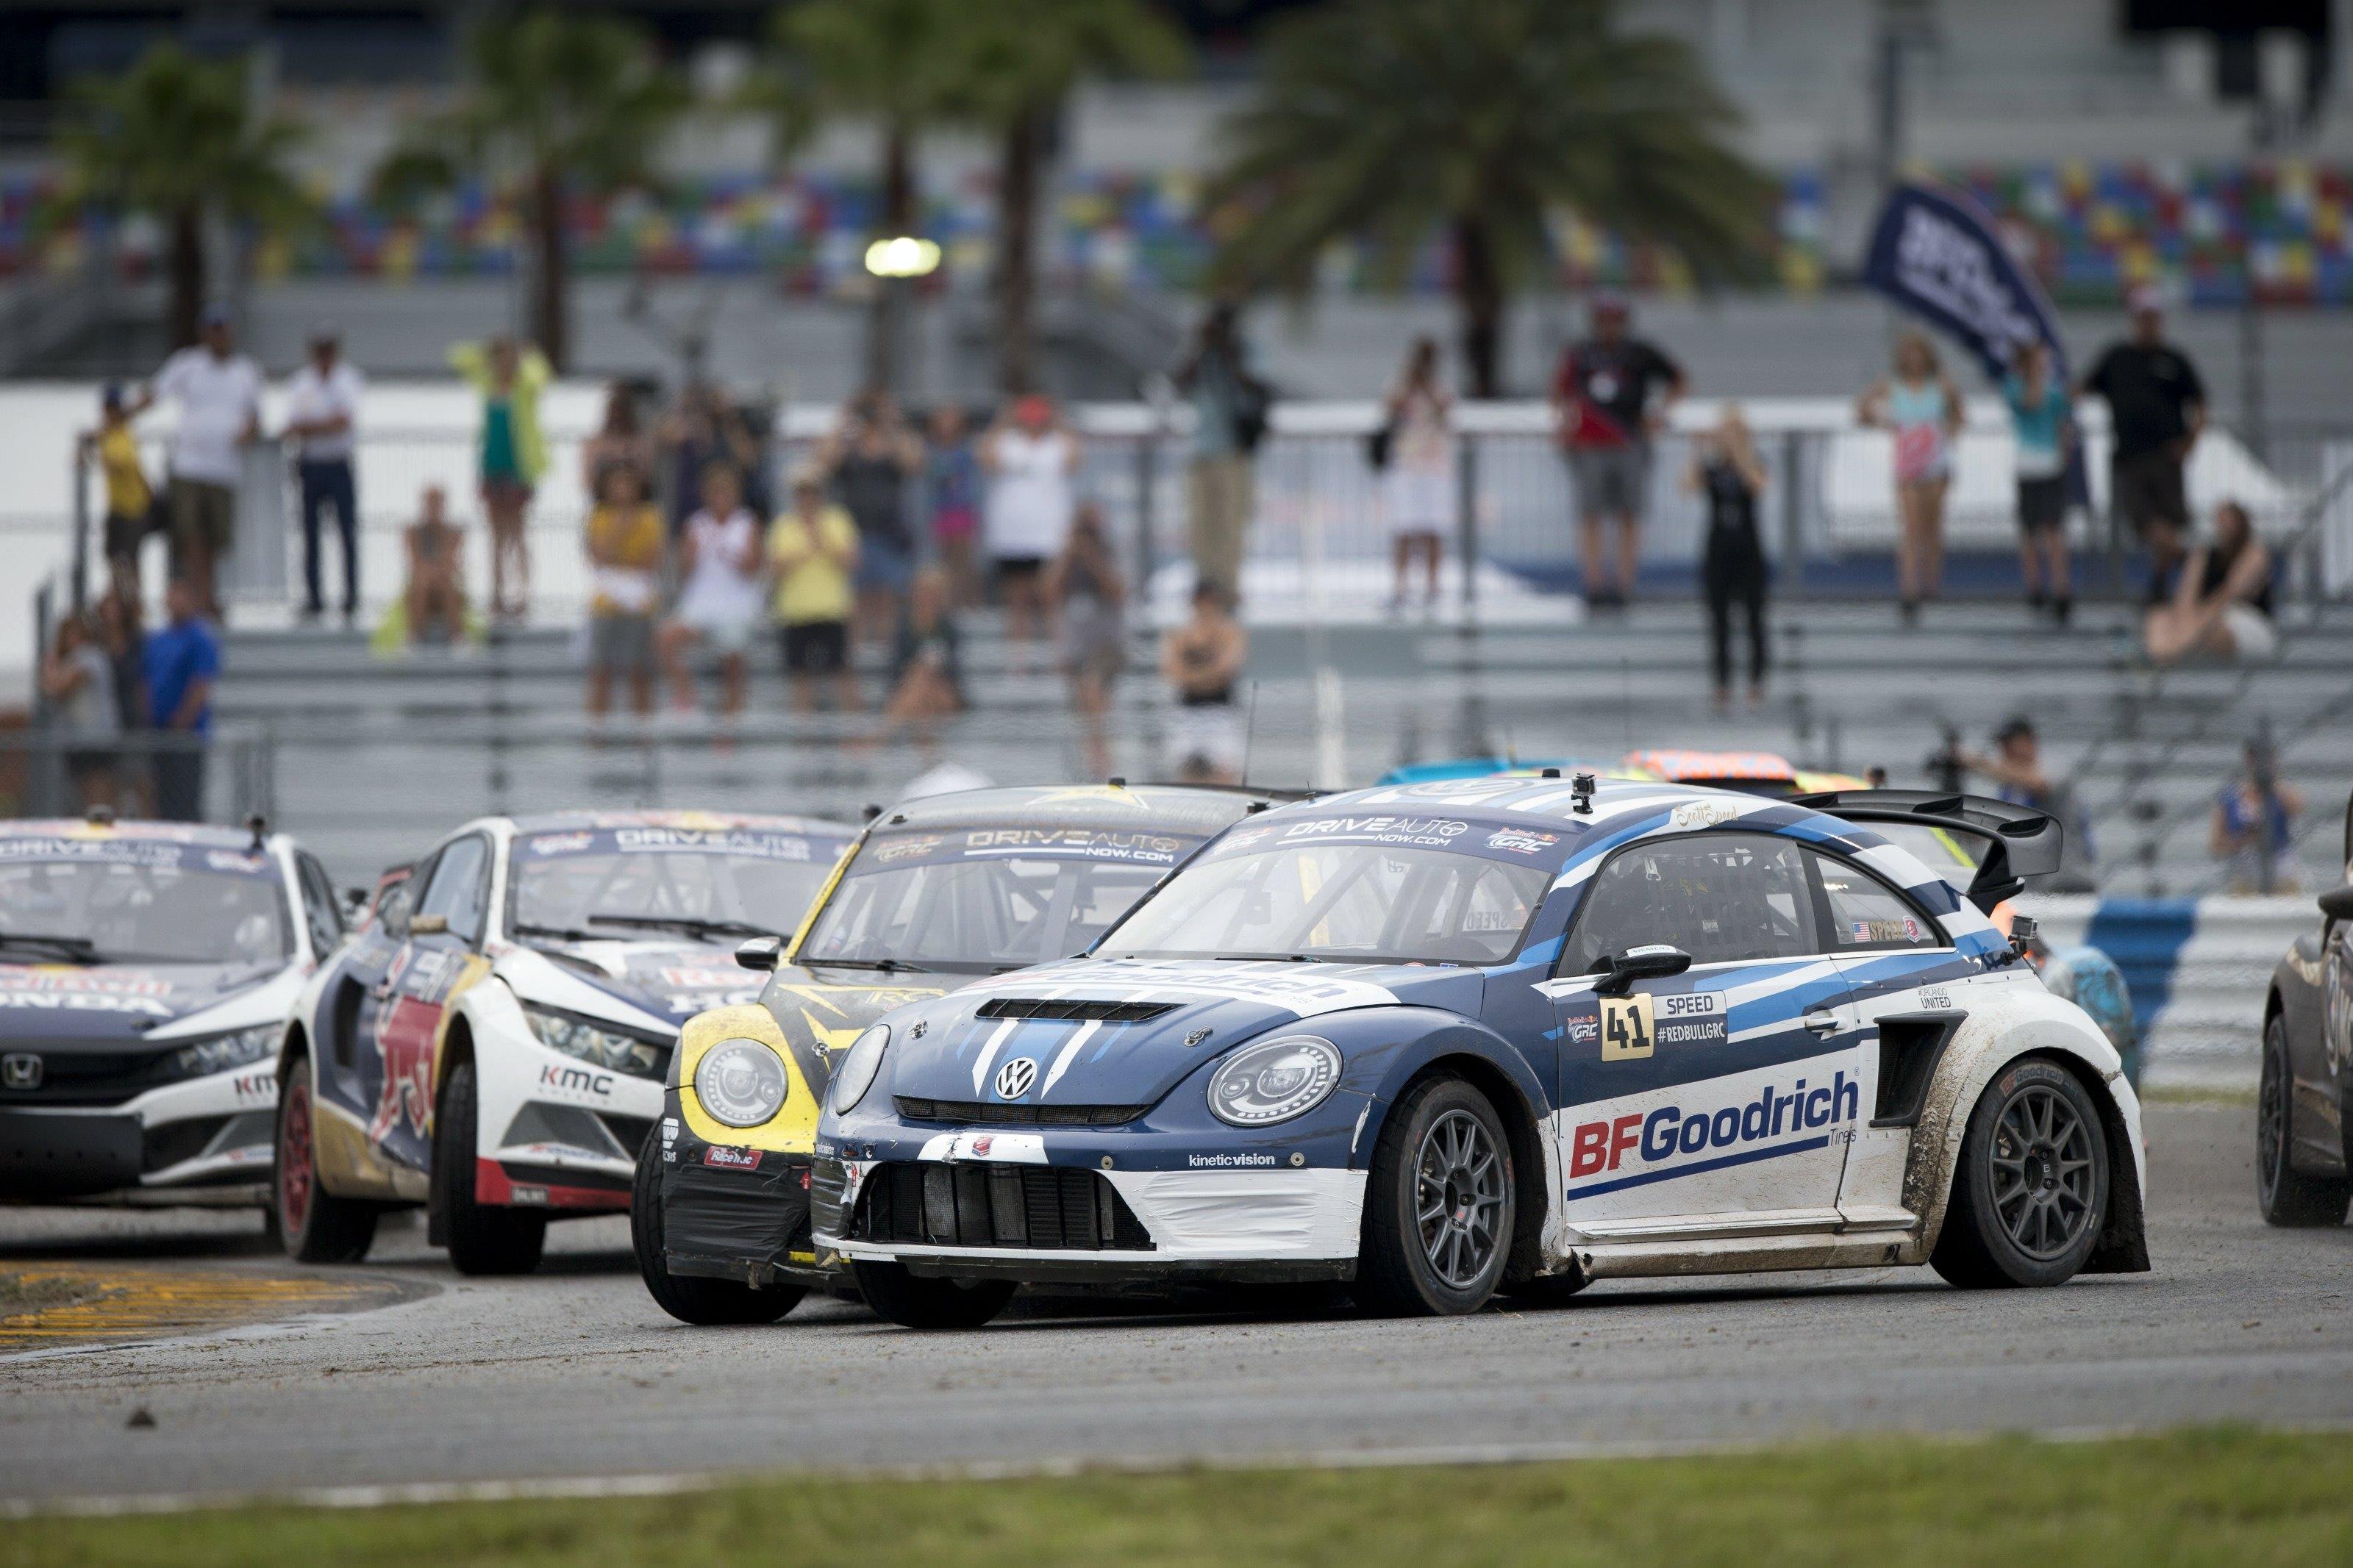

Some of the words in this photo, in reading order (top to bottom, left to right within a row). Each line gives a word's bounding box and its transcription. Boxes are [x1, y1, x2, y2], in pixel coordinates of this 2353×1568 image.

[1285, 817, 1468, 836] DRIVEAUTO
[967, 830, 1179, 852] DRIVEAUTO
[1374, 834, 1452, 845] NOW.COM
[1085, 847, 1174, 862] NOW.COM
[1667, 995, 1713, 1014] SPEED
[1921, 996, 1952, 1009] UNITED
[1607, 1005, 1650, 1049] 41
[1657, 1022, 1725, 1043] #REDBULLGRC
[234, 1075, 275, 1094] KM
[540, 1065, 613, 1095] KMC
[1569, 1070, 1859, 1179] BFGoodrich
[1830, 1127, 1857, 1146] Tires
